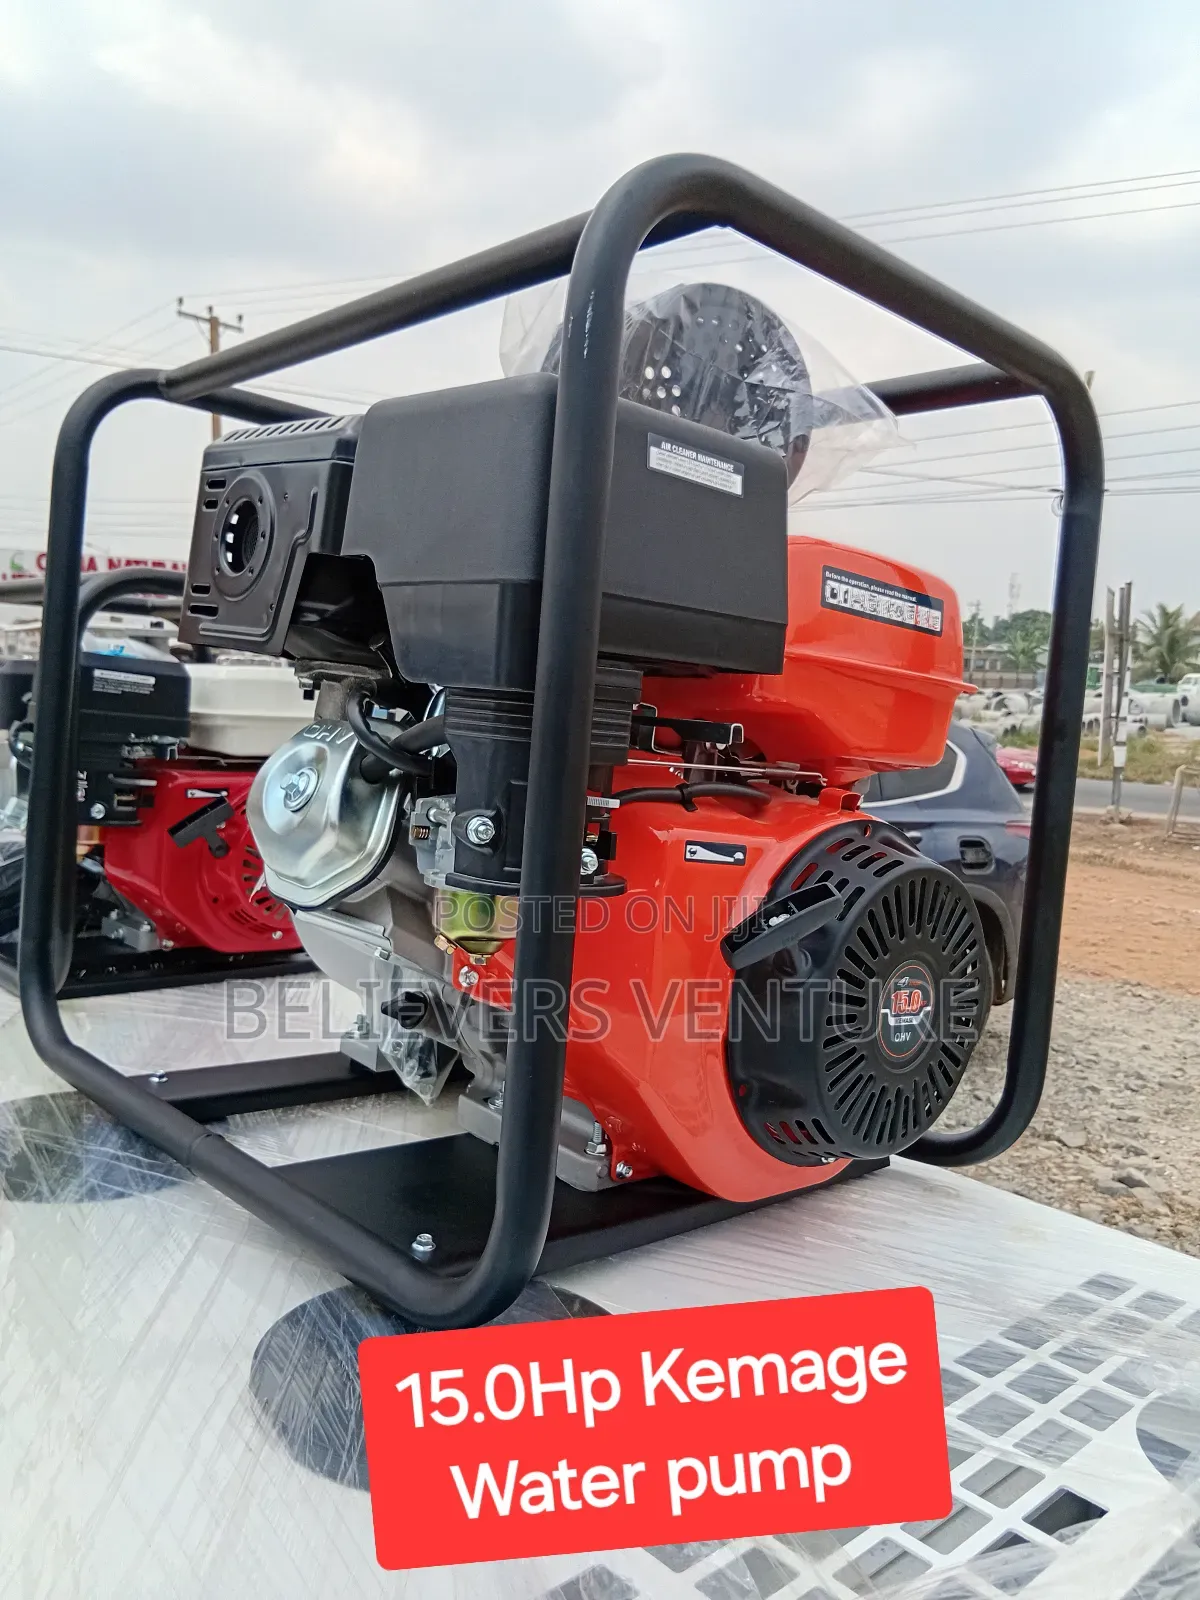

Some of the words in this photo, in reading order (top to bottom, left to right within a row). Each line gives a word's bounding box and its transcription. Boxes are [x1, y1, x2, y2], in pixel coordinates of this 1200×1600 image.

[661, 441, 672, 452] AIR
[671, 444, 697, 460] CLEANER
[697, 453, 735, 473] MAINTENANCE
[825, 570, 841, 581] Before
[840, 576, 849, 584] the
[848, 579, 871, 591] operation,
[870, 585, 885, 595] please
[884, 588, 895, 597] read
[894, 591, 902, 599] the
[303, 724, 355, 745] OHV
[891, 989, 921, 1014] 15.0
[894, 1031, 912, 1042] OHV
